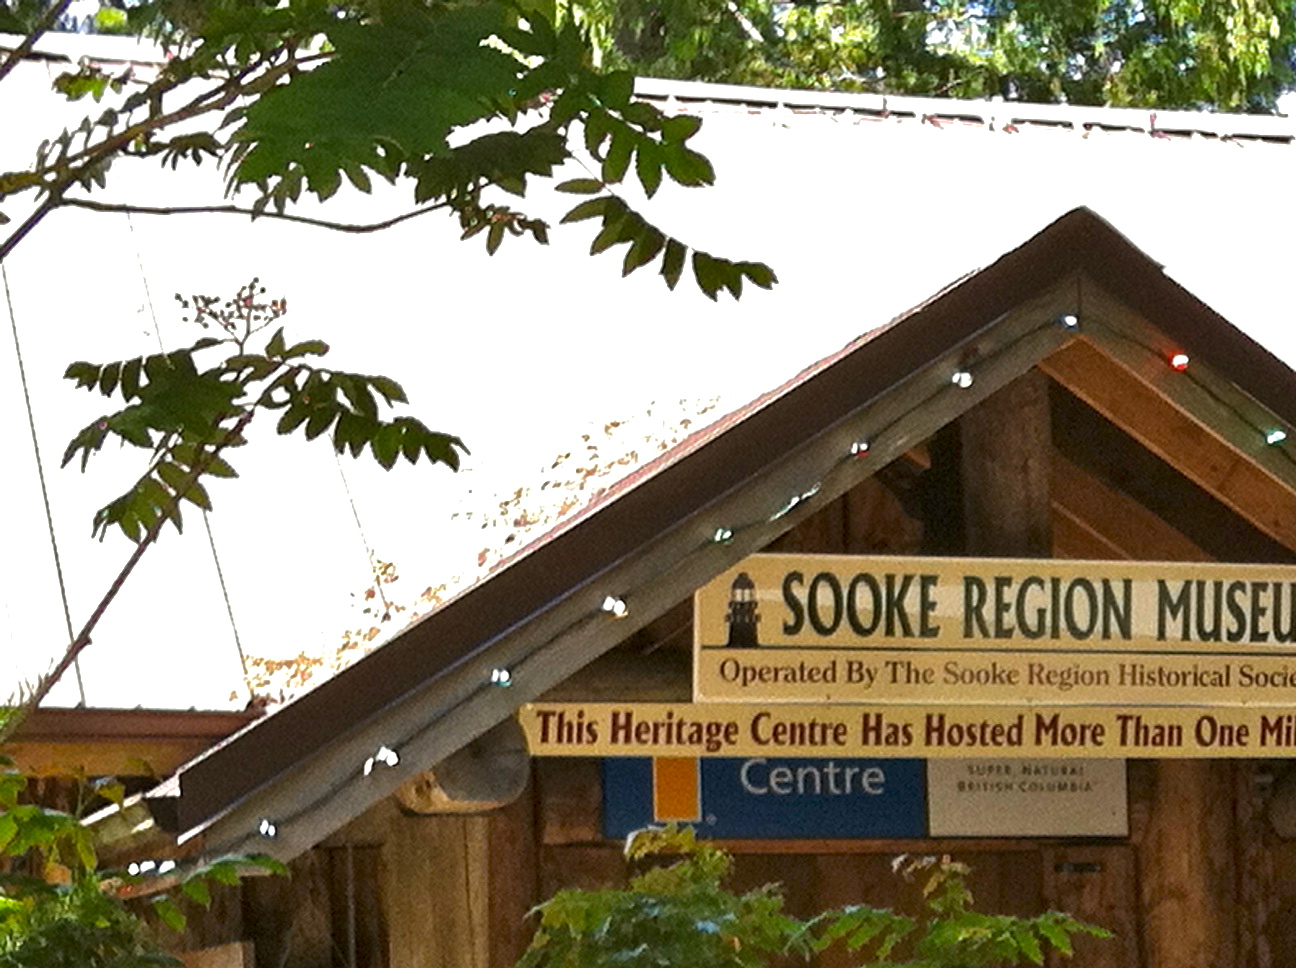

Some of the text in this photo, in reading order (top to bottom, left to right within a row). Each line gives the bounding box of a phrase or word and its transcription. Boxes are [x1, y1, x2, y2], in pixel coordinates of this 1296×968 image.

[782, 571, 941, 638] SOOKE
[962, 575, 1133, 641] REGION
[719, 658, 837, 687] Operated
[845, 660, 880, 690] By
[884, 660, 935, 685] The
[942, 661, 1020, 686] Sooke
[1028, 663, 1110, 692] Region
[1118, 663, 1231, 688] Historical
[536, 710, 598, 745] This
[610, 710, 739, 752] Heritage
[750, 712, 848, 747] Centre
[860, 712, 913, 747] Has
[924, 712, 1025, 747] Hosted
[1034, 712, 1105, 747] More
[1115, 713, 1183, 747] Than
[1194, 714, 1249, 747] One
[739, 758, 886, 795] Centre
[957, 780, 1094, 793] BRITISH COLUMBIA
